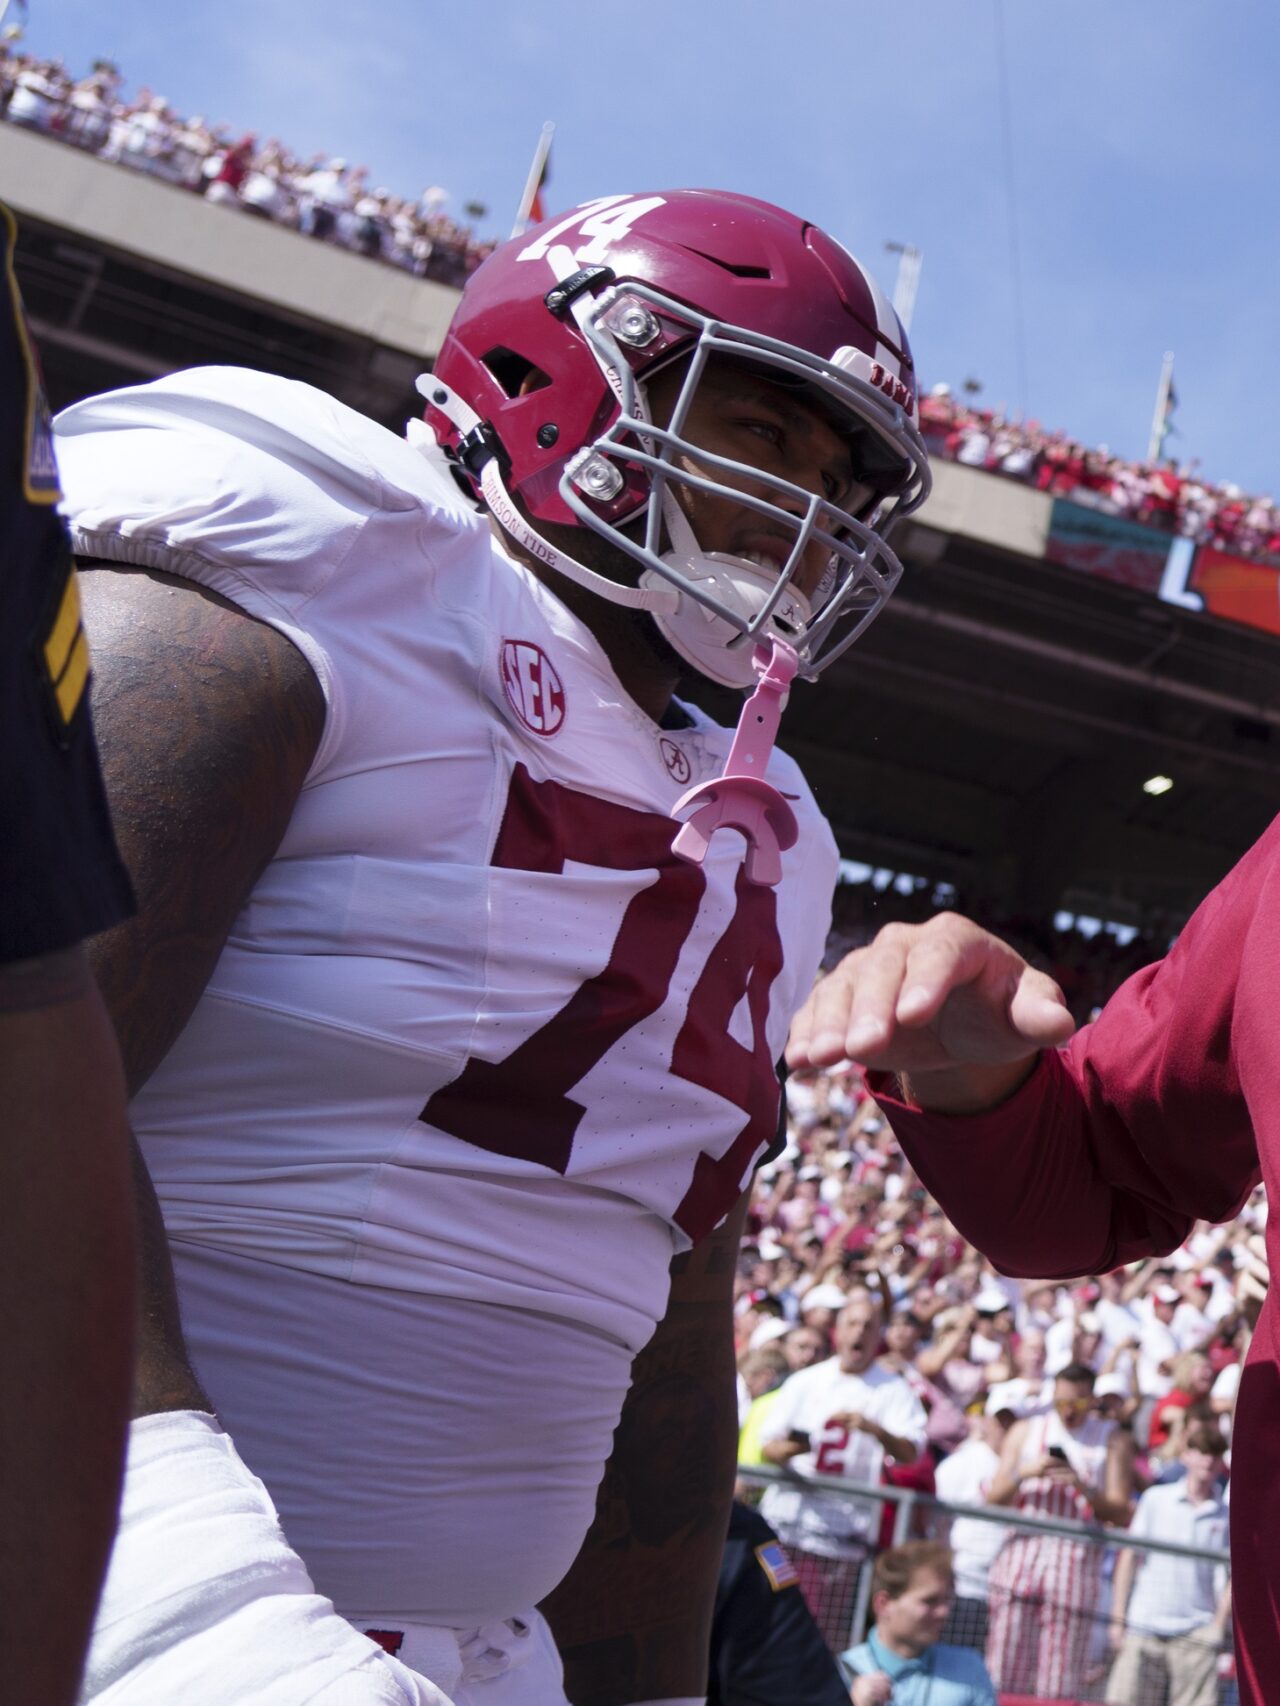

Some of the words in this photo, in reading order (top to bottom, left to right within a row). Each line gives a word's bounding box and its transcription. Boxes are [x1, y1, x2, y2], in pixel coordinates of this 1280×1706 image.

[515, 194, 667, 265] 74
[522, 529, 558, 566] TIDE
[502, 641, 564, 733] SEC
[419, 761, 785, 1244] 74
[816, 1418, 849, 1474] 2
